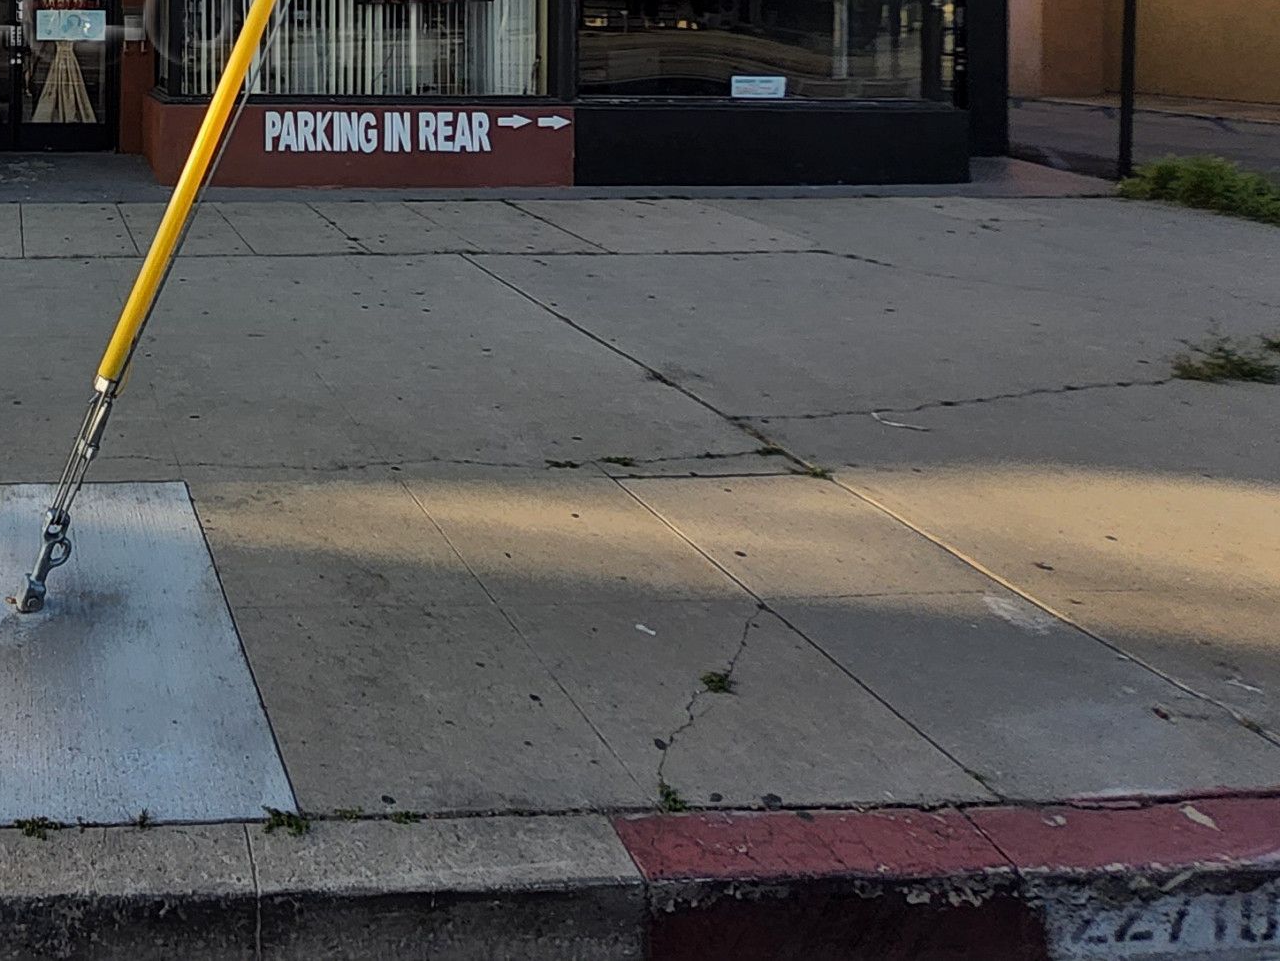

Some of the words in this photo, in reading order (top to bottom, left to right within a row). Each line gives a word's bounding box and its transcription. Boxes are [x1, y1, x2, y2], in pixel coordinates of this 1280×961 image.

[264, 111, 379, 154] PARKING
[383, 111, 412, 153] IN
[418, 111, 492, 153] REAR
